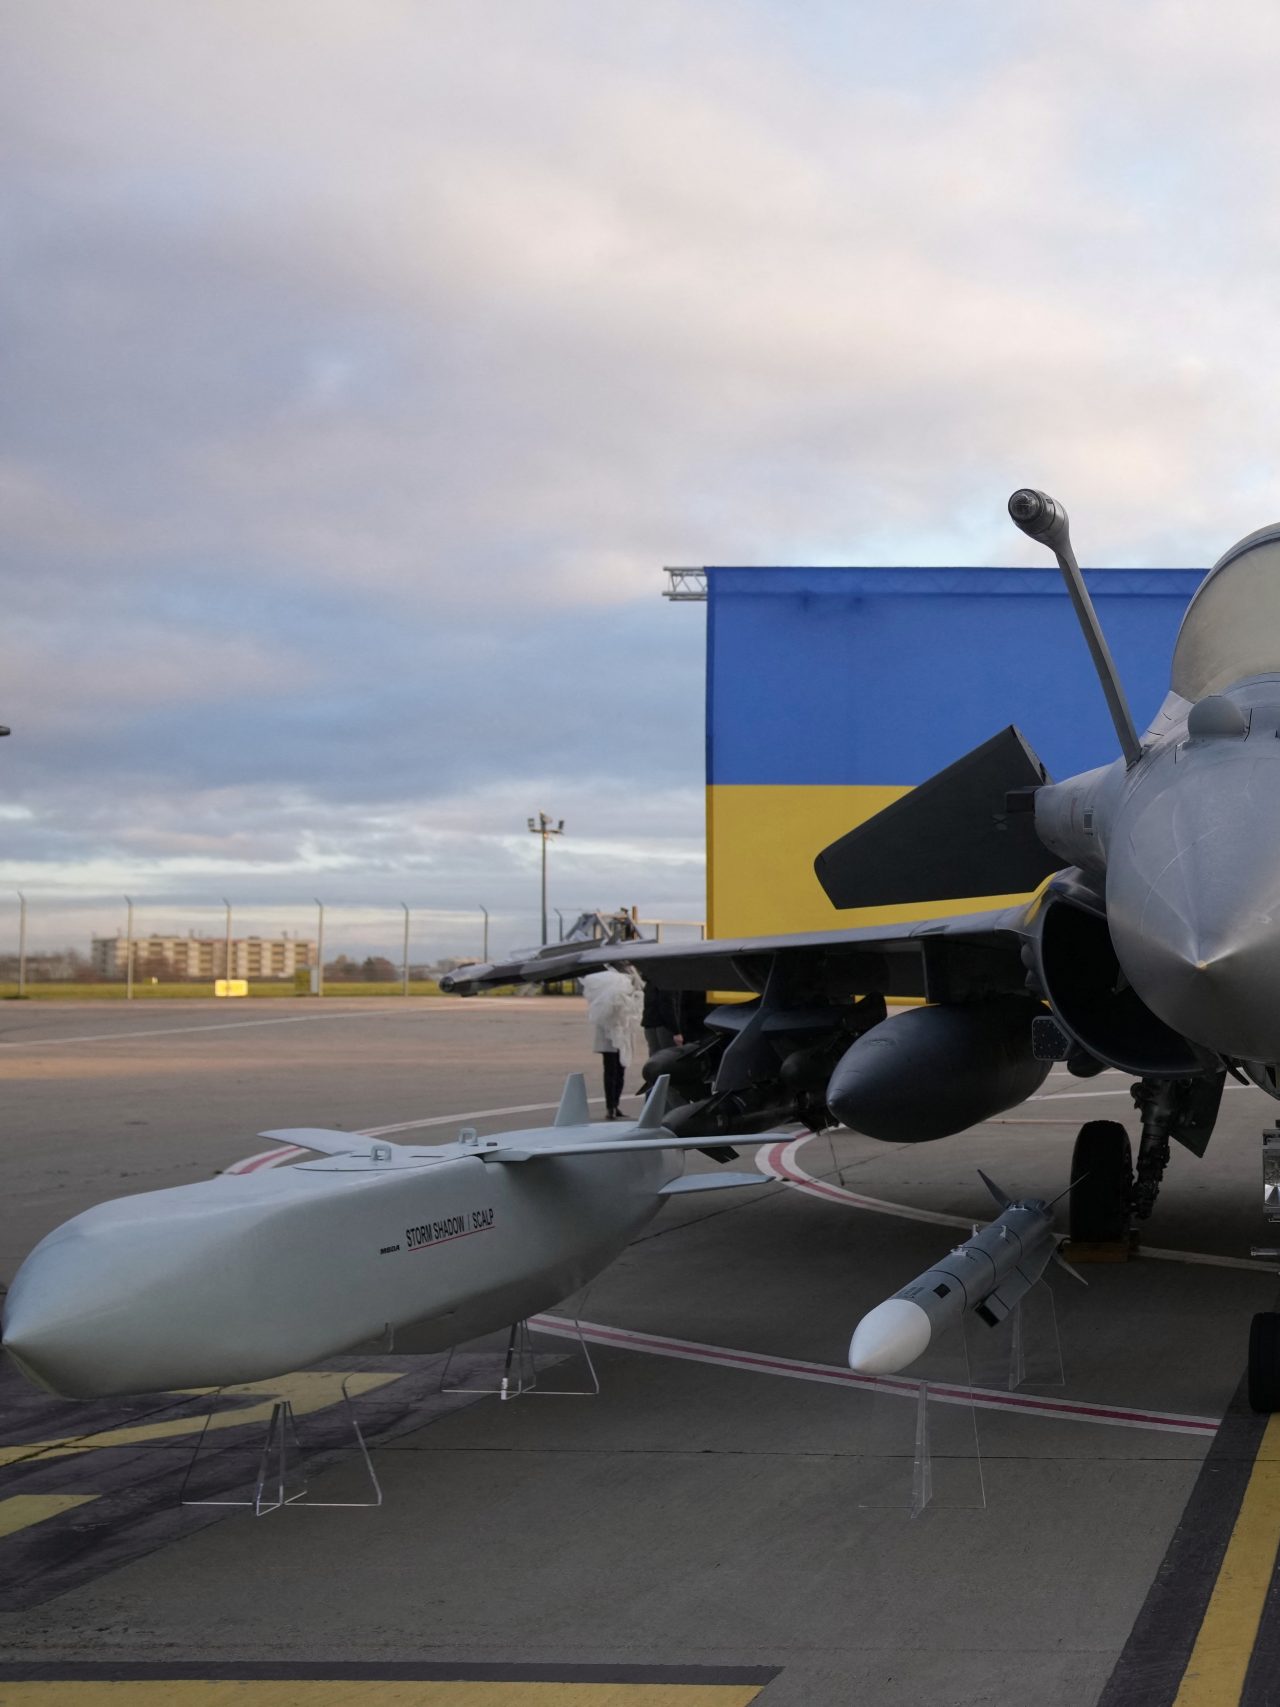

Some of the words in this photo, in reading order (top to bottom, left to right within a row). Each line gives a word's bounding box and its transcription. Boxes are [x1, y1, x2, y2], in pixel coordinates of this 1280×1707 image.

[406, 1224, 433, 1247] STORM
[433, 1215, 465, 1240] SHADOW
[472, 1208, 494, 1229] SCALP
